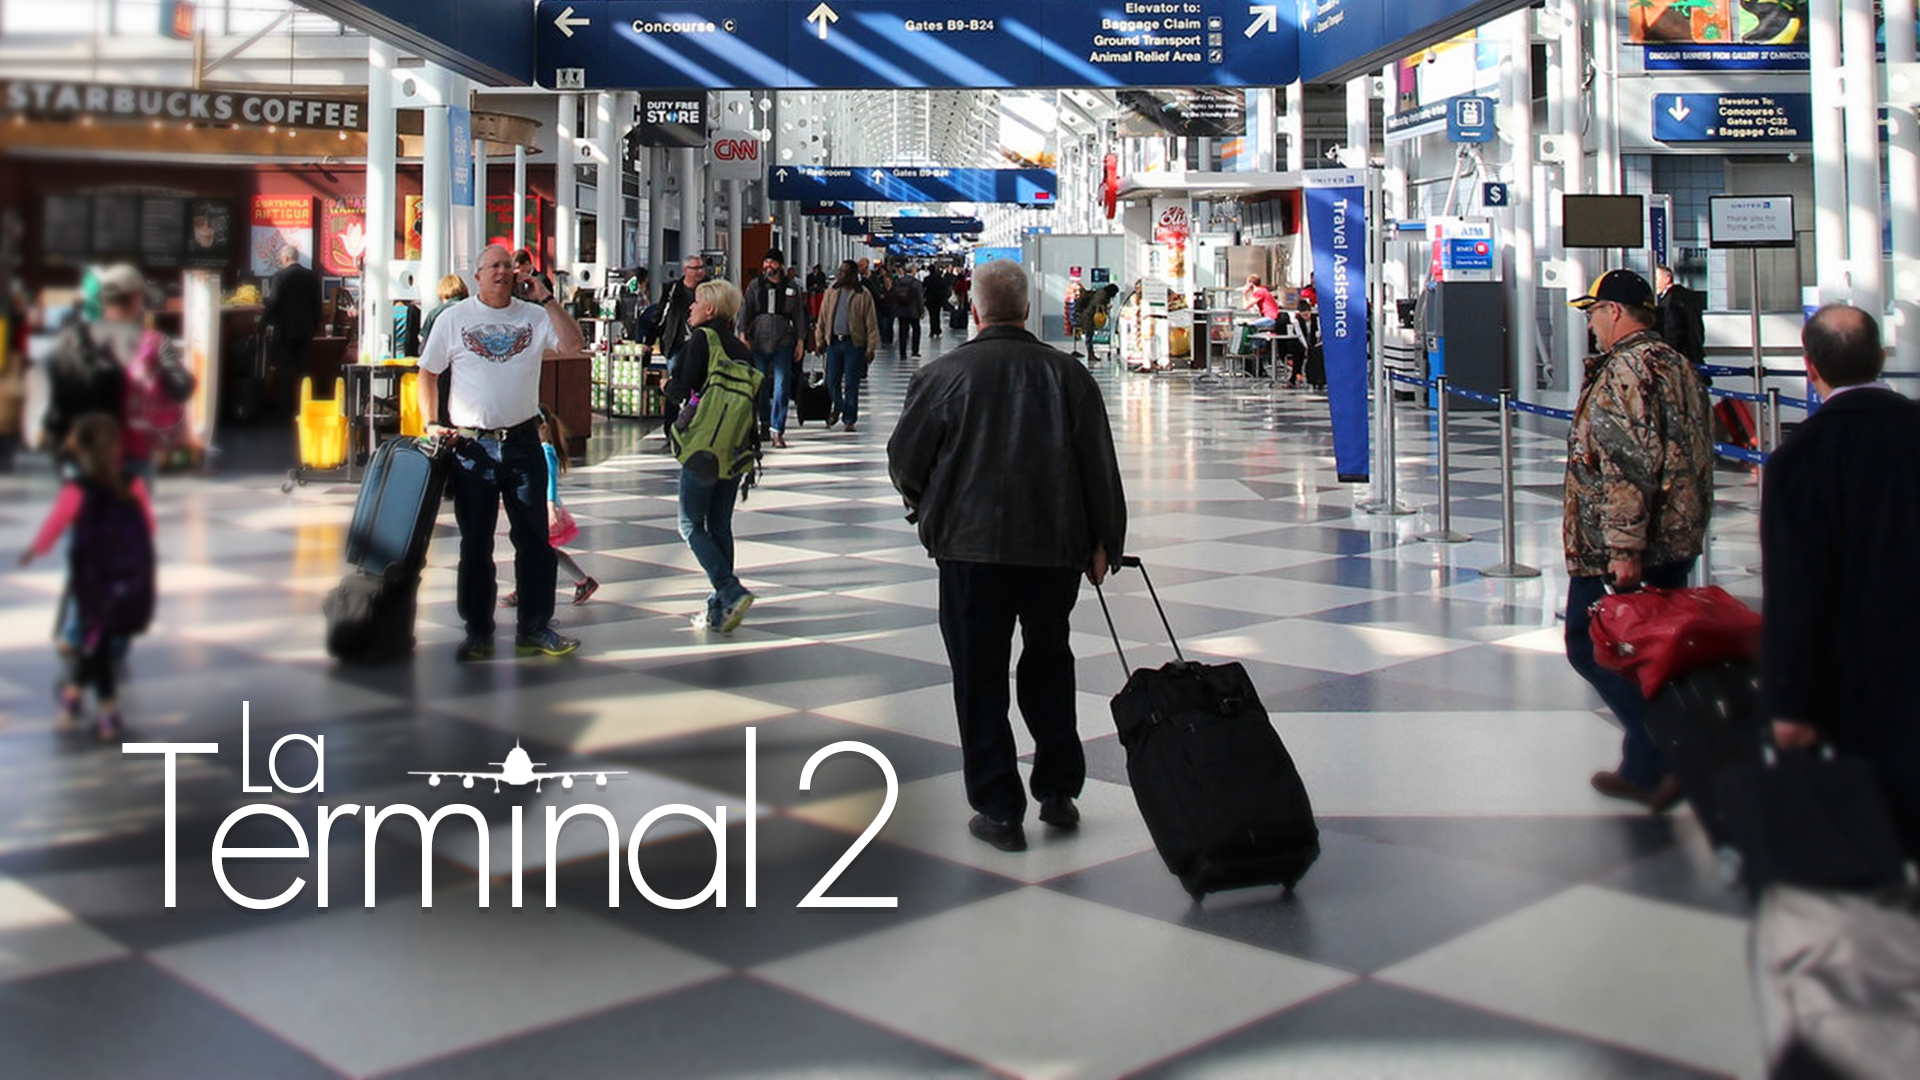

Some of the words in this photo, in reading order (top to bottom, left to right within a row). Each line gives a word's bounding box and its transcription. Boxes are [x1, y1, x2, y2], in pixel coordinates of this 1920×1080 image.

[1125, 3, 1180, 13] Elevator
[1183, 3, 1201, 13] to:
[632, 19, 716, 33] Concourse
[723, 19, 736, 32] C
[905, 19, 943, 32] Gates
[947, 19, 994, 32] B9-B24
[1102, 19, 1160, 33] Baggage
[1163, 18, 1201, 30] Claim
[1094, 35, 1138, 46] Ground
[1141, 35, 1201, 48] Transport
[1089, 51, 1132, 63] Animal
[1134, 51, 1170, 62] Relief
[1173, 51, 1202, 62] Area
[1732, 51, 1759, 60] GALLERY
[7, 82, 234, 121] STARBUCKS
[241, 96, 358, 128] COFFEE
[647, 101, 674, 110] DUTY
[675, 101, 699, 110] FREE
[1718, 97, 1759, 106] Elevators
[647, 110, 699, 123] STORE
[1719, 107, 1774, 116] Concourse
[1776, 107, 1784, 115] C
[1726, 117, 1753, 126] Gates
[1755, 117, 1788, 126] C1-C32
[1719, 127, 1765, 138] Baggage
[1767, 127, 1797, 136] Claim
[714, 139, 758, 161] CNN
[806, 168, 851, 177] Restrooms
[254, 208, 310, 220] ANTIGUA
[1333, 198, 1348, 250] Travel
[1460, 226, 1484, 236] ATM
[1333, 253, 1348, 338] Assistance
